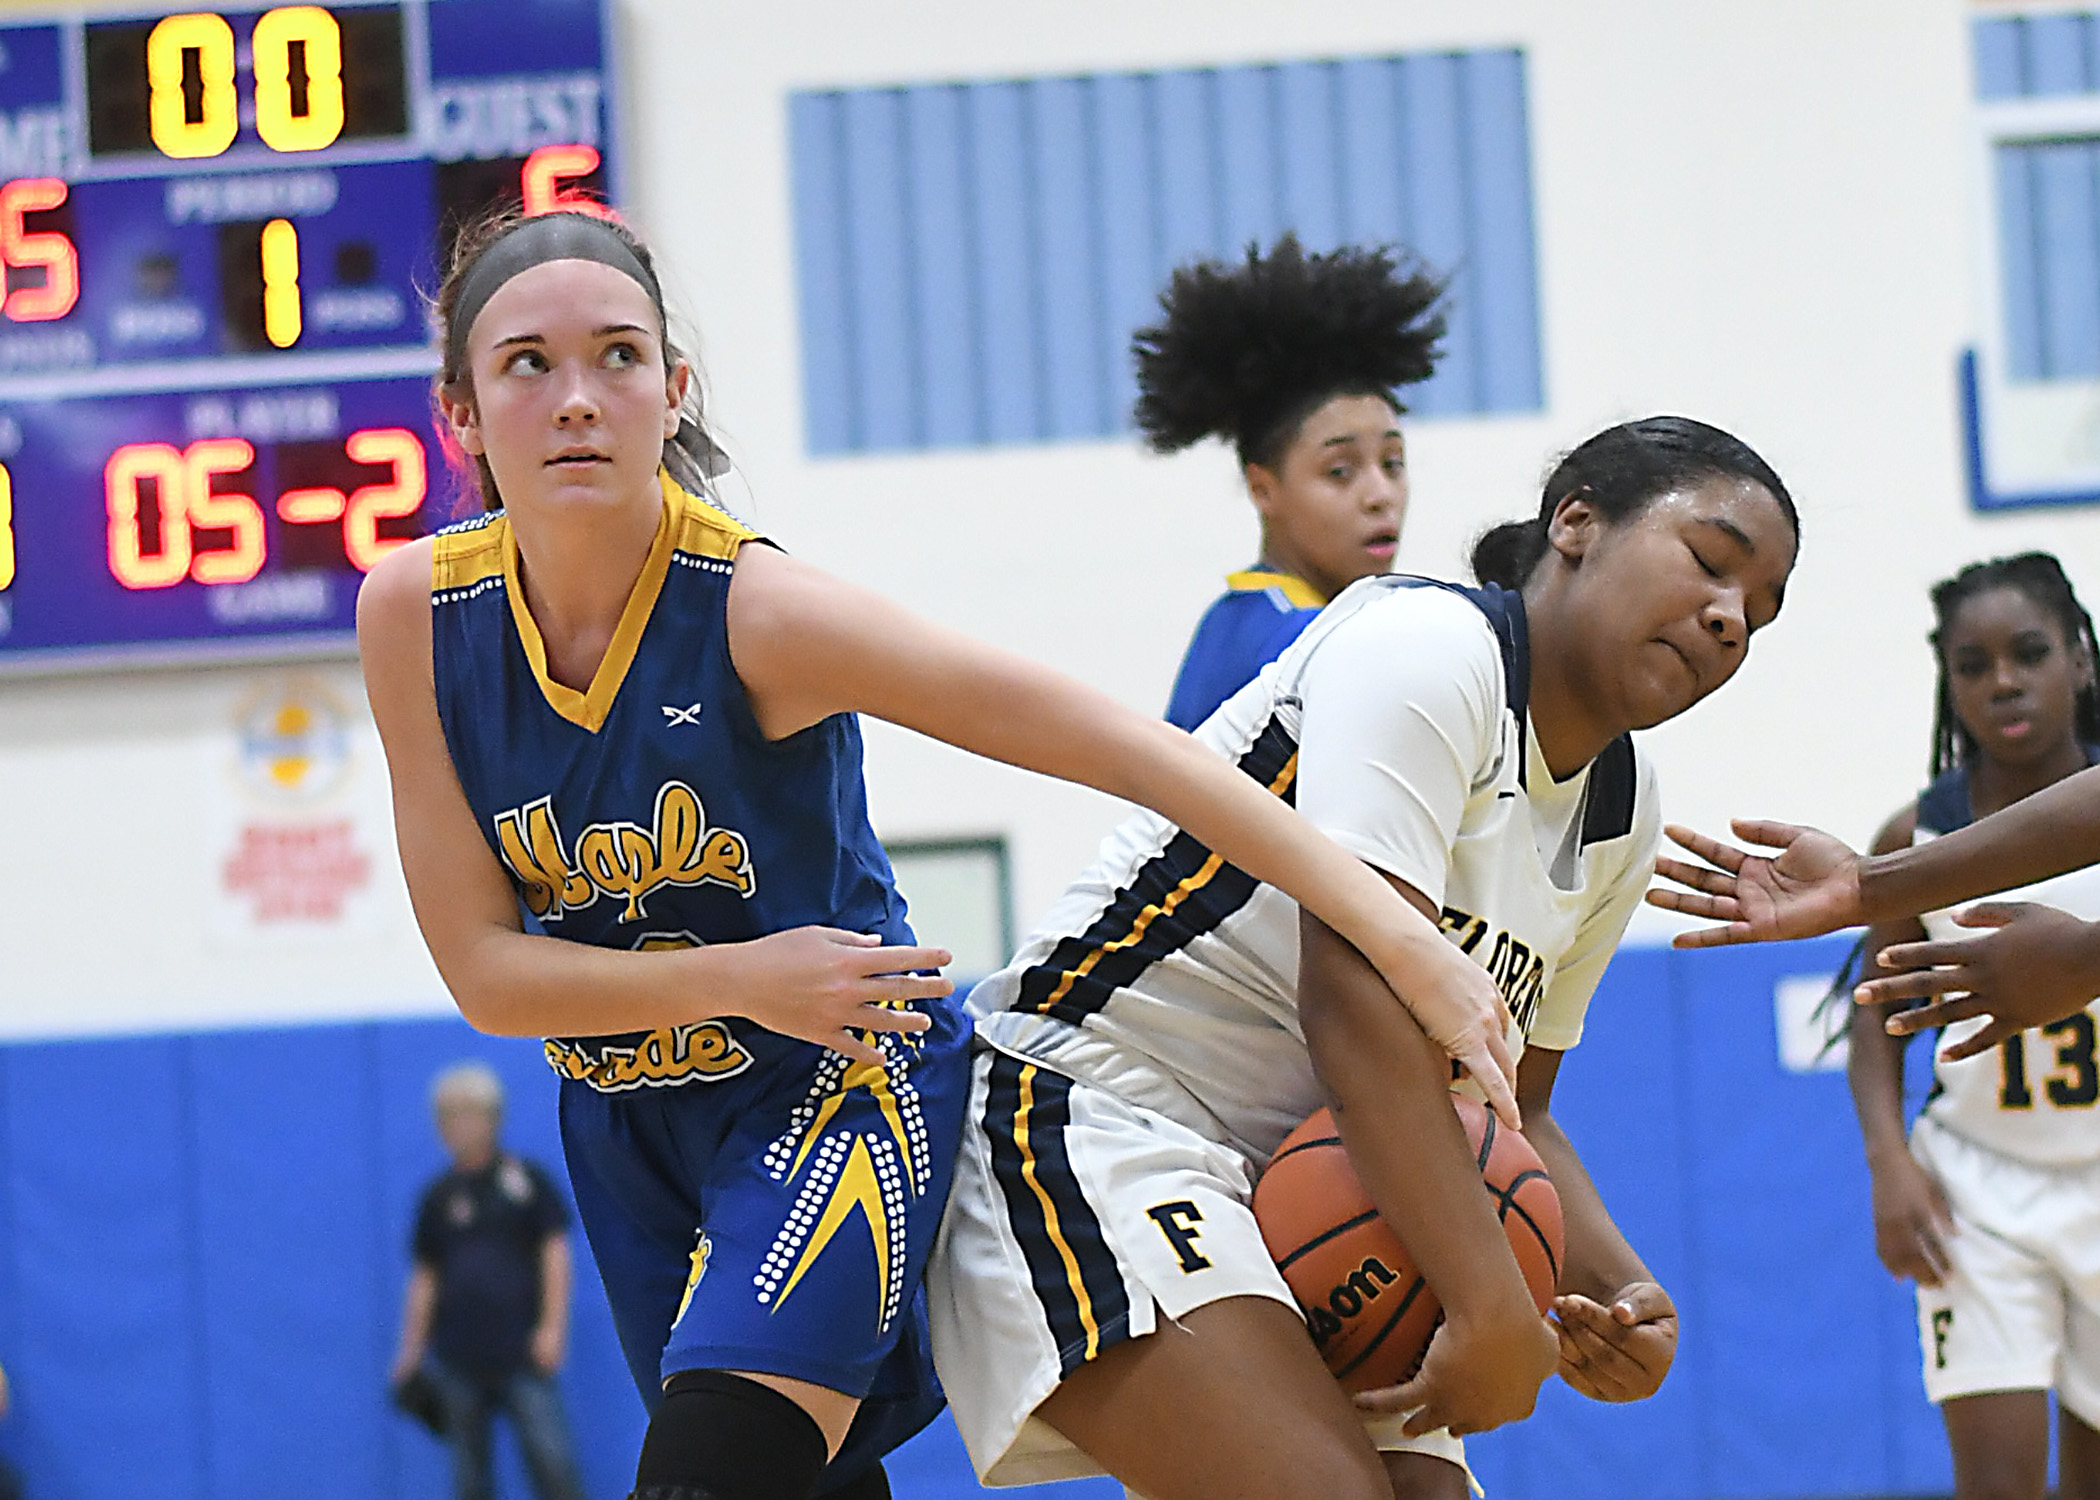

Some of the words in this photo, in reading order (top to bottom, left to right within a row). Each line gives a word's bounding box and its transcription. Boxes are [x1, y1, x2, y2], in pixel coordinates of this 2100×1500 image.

[147, 6, 345, 159] 00
[0, 177, 80, 322] 5
[261, 218, 301, 348] 1
[494, 780, 757, 923] Maple
[1996, 1009, 2099, 1112] 13
[1145, 1199, 1213, 1275] F
